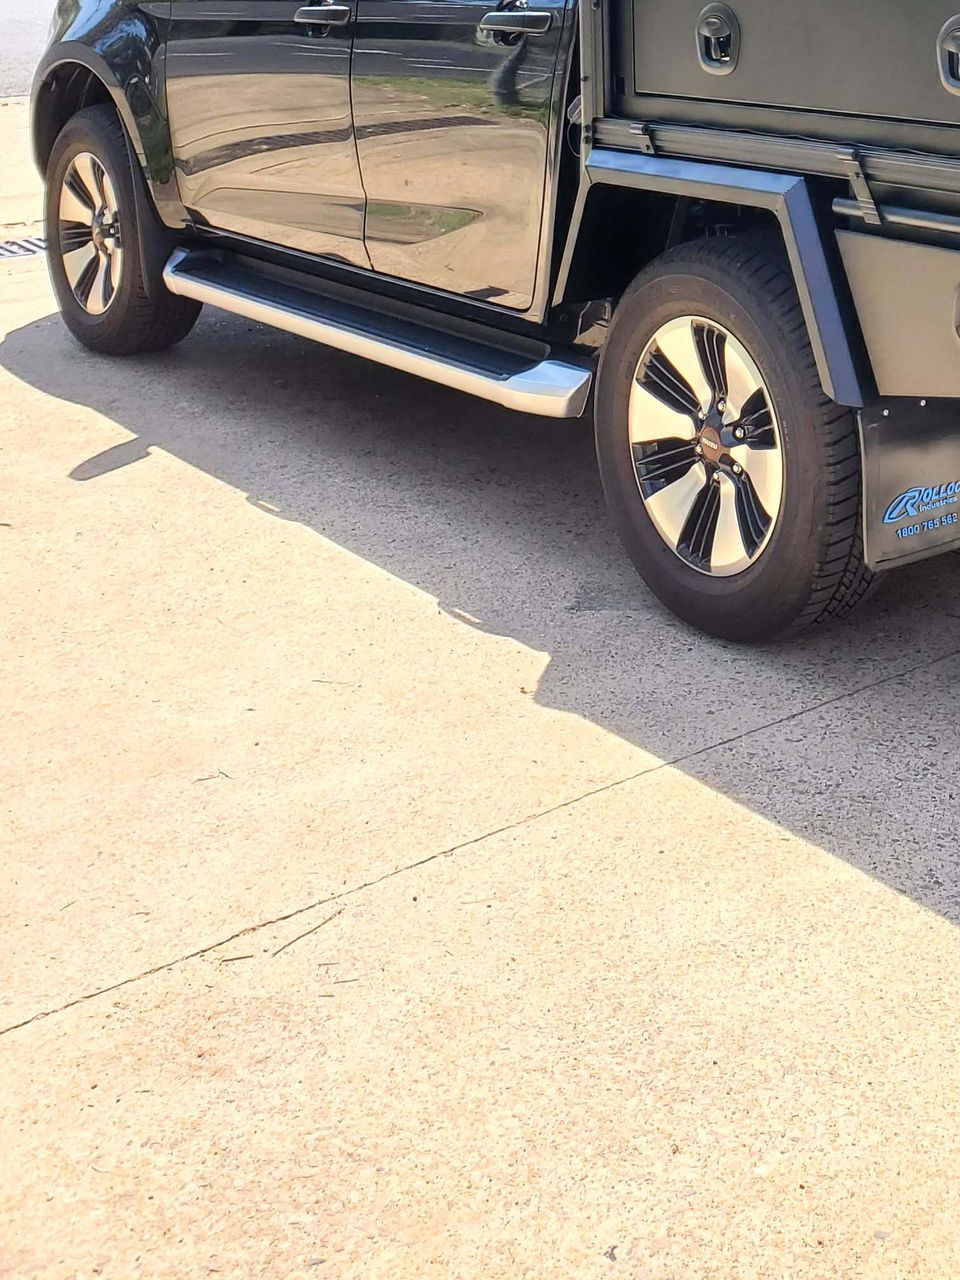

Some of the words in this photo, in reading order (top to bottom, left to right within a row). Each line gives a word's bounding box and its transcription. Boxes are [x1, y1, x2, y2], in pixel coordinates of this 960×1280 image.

[919, 496, 958, 512] Industries
[896, 524, 920, 538] 1800
[922, 518, 939, 531] 765
